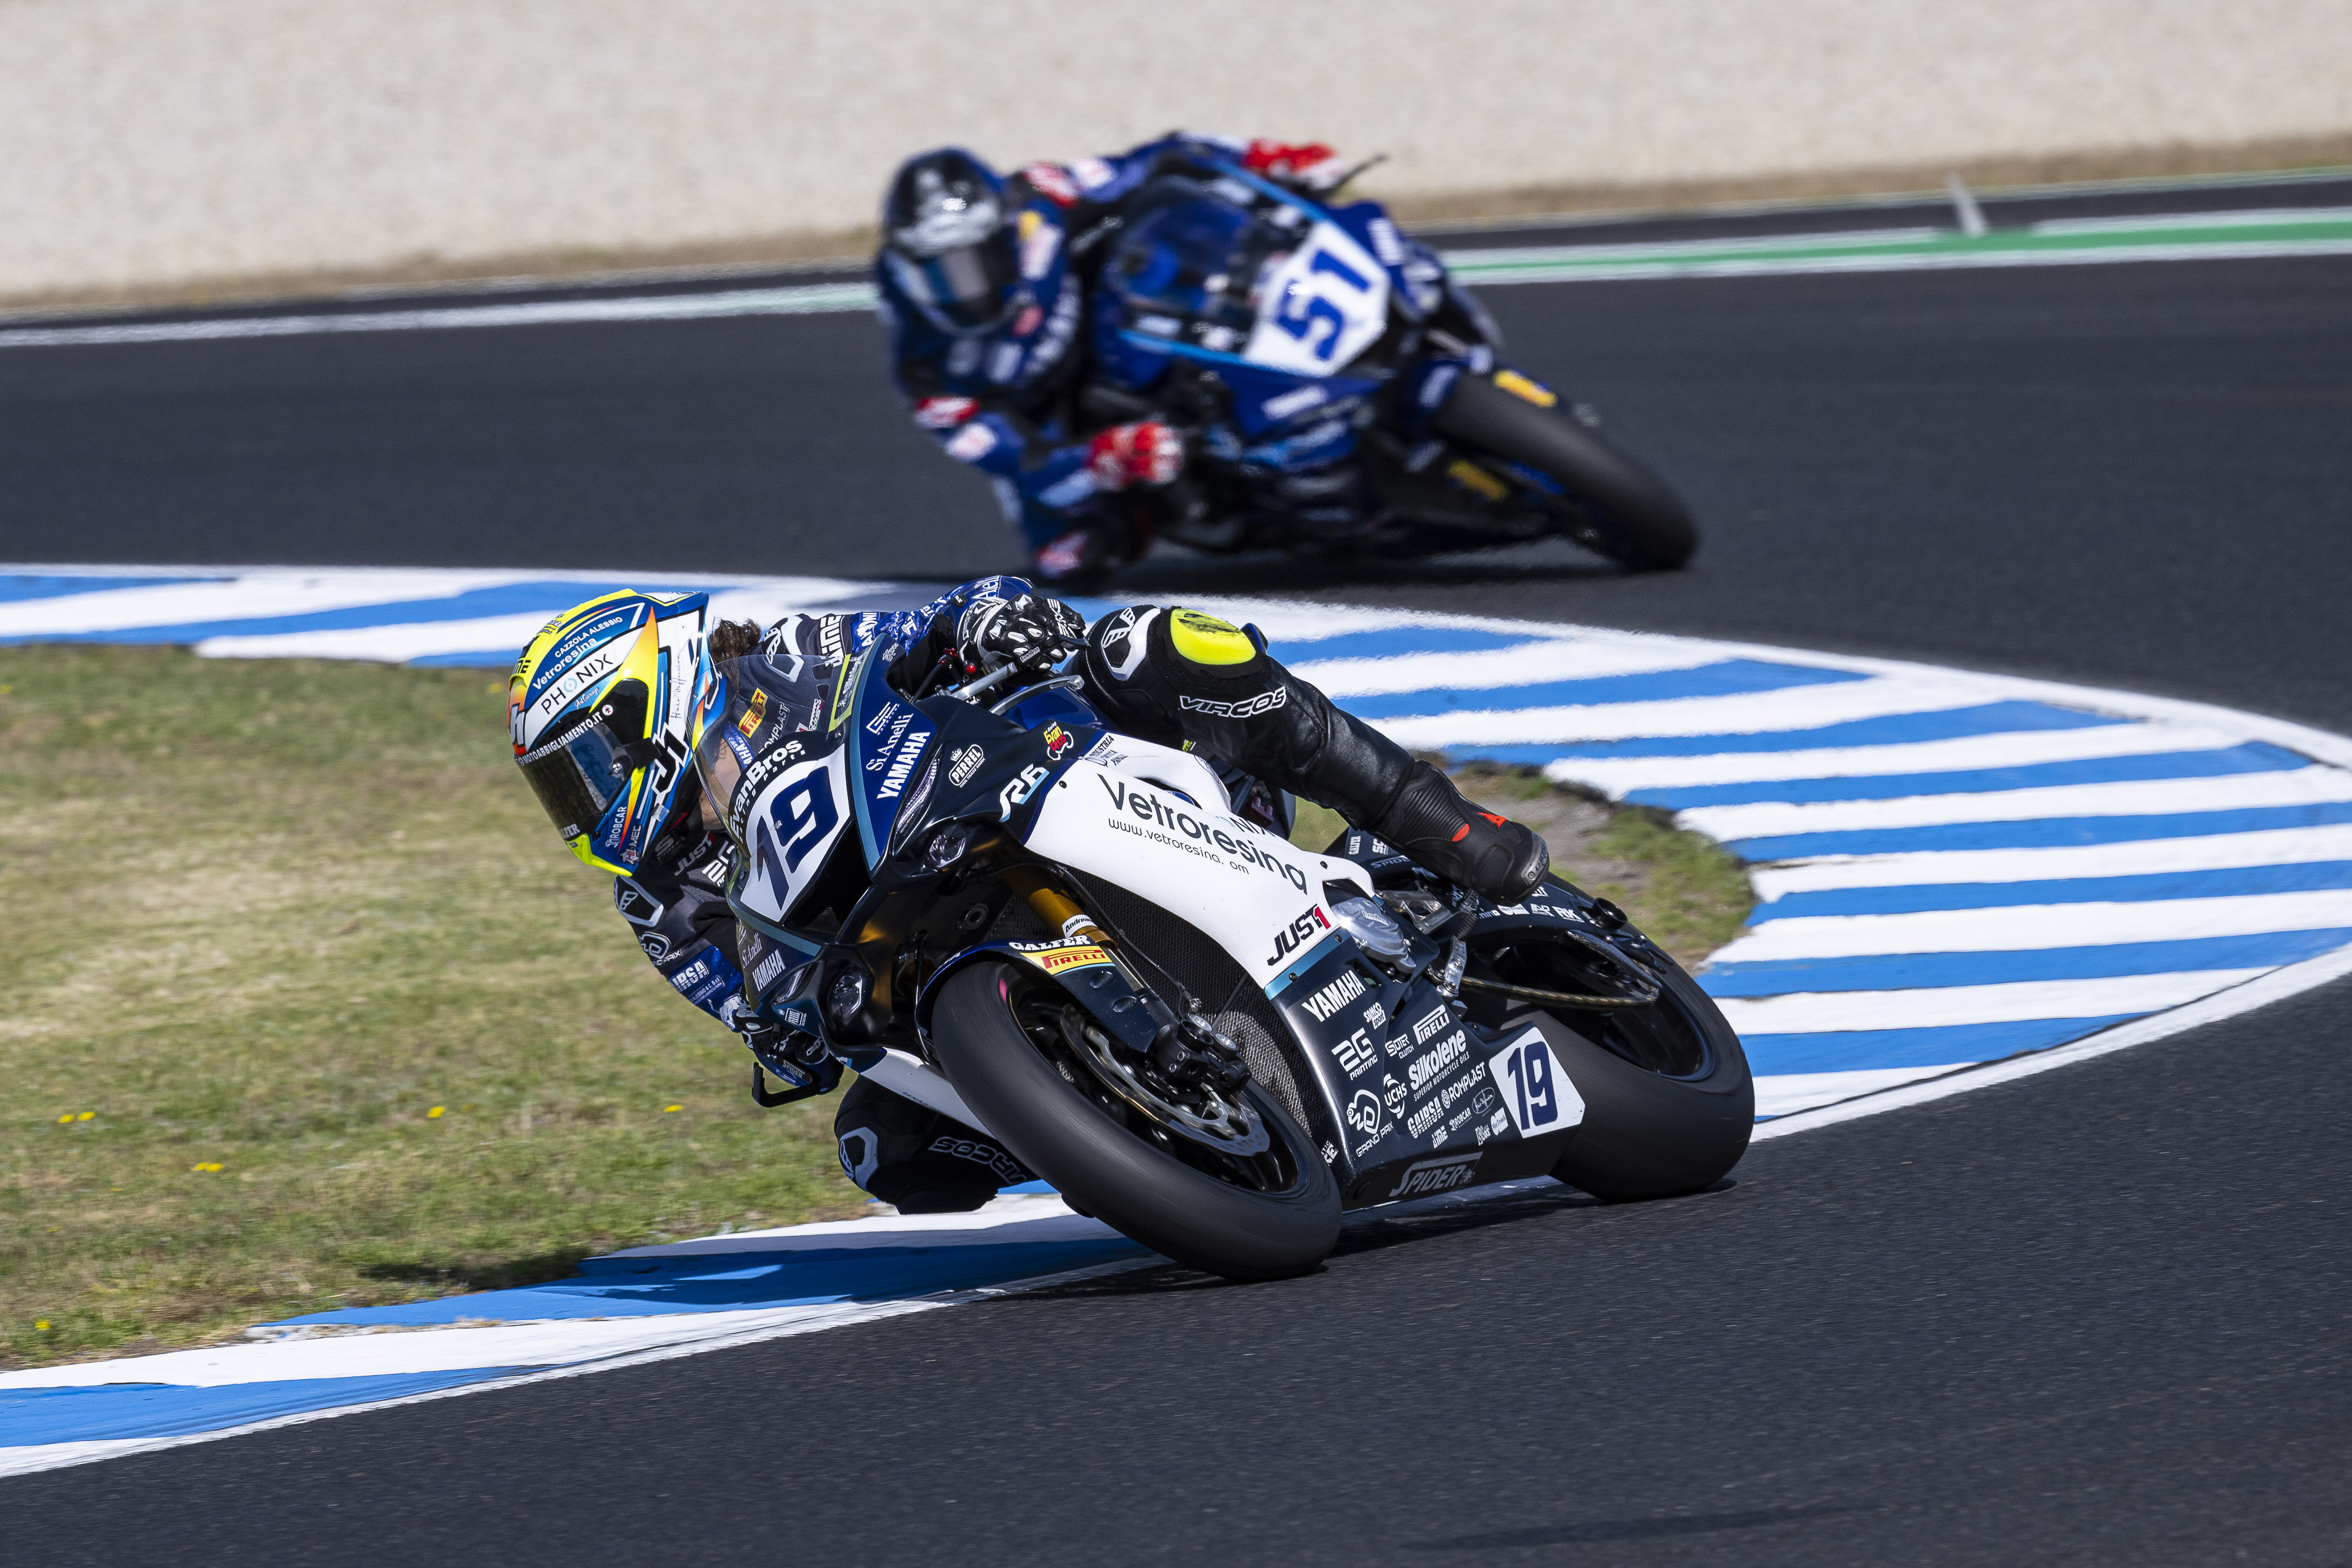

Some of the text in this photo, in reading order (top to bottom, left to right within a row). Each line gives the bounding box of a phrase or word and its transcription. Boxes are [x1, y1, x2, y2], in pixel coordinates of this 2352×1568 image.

[1277, 246, 1373, 362] 51
[555, 632, 590, 658] CAZZOLA
[589, 617, 623, 635] ALESSIO
[532, 637, 598, 690] Vetroresina
[1180, 686, 1286, 718] VIRCOS
[522, 711, 603, 765] MOTOABBIGLIAMENTO.IT
[759, 702, 790, 754] OMPLAST
[1043, 726, 1063, 745] Evan
[736, 743, 753, 765] AHA
[877, 731, 931, 800] YAMAHA
[951, 748, 981, 783] PERREL
[960, 757, 985, 788] TOOL TRADE MARK
[730, 740, 803, 840] EvanBros
[674, 831, 716, 875] JUST1
[756, 765, 839, 912] 19
[1096, 773, 1308, 895] Vetroresina
[1108, 817, 1250, 875] www.vetroresina.om
[1370, 855, 1411, 869] SPID
[1065, 917, 1094, 934] Andrea
[1552, 905, 1583, 920] RK
[1008, 934, 1091, 951] GALFER
[1267, 904, 1331, 967] JUST1
[670, 961, 707, 992] IRSA
[752, 948, 786, 992] YAMAHA
[1041, 950, 1106, 969] PIRELLI
[1301, 969, 1366, 1022] YAMAHA
[1363, 1002, 1383, 1023] SAMCO
[1385, 1033, 1410, 1057] SUTER
[1413, 1004, 1451, 1045] PIRELLI
[782, 1059, 806, 1079] SPIDER
[1349, 1055, 1378, 1081] PRINTING
[1398, 1044, 1415, 1059] CLUTCH
[1408, 1029, 1466, 1091] Silkolene
[1384, 1082, 1408, 1107] UCHS
[1414, 1051, 1470, 1102] SUPERIOR MOTORCYCLE OILS
[1448, 1062, 1486, 1103] ROMPLAST
[1507, 1041, 1558, 1131] 19
[1355, 1121, 1394, 1158] GRAND PRIX
[1389, 1151, 1484, 1198] SPIDER
